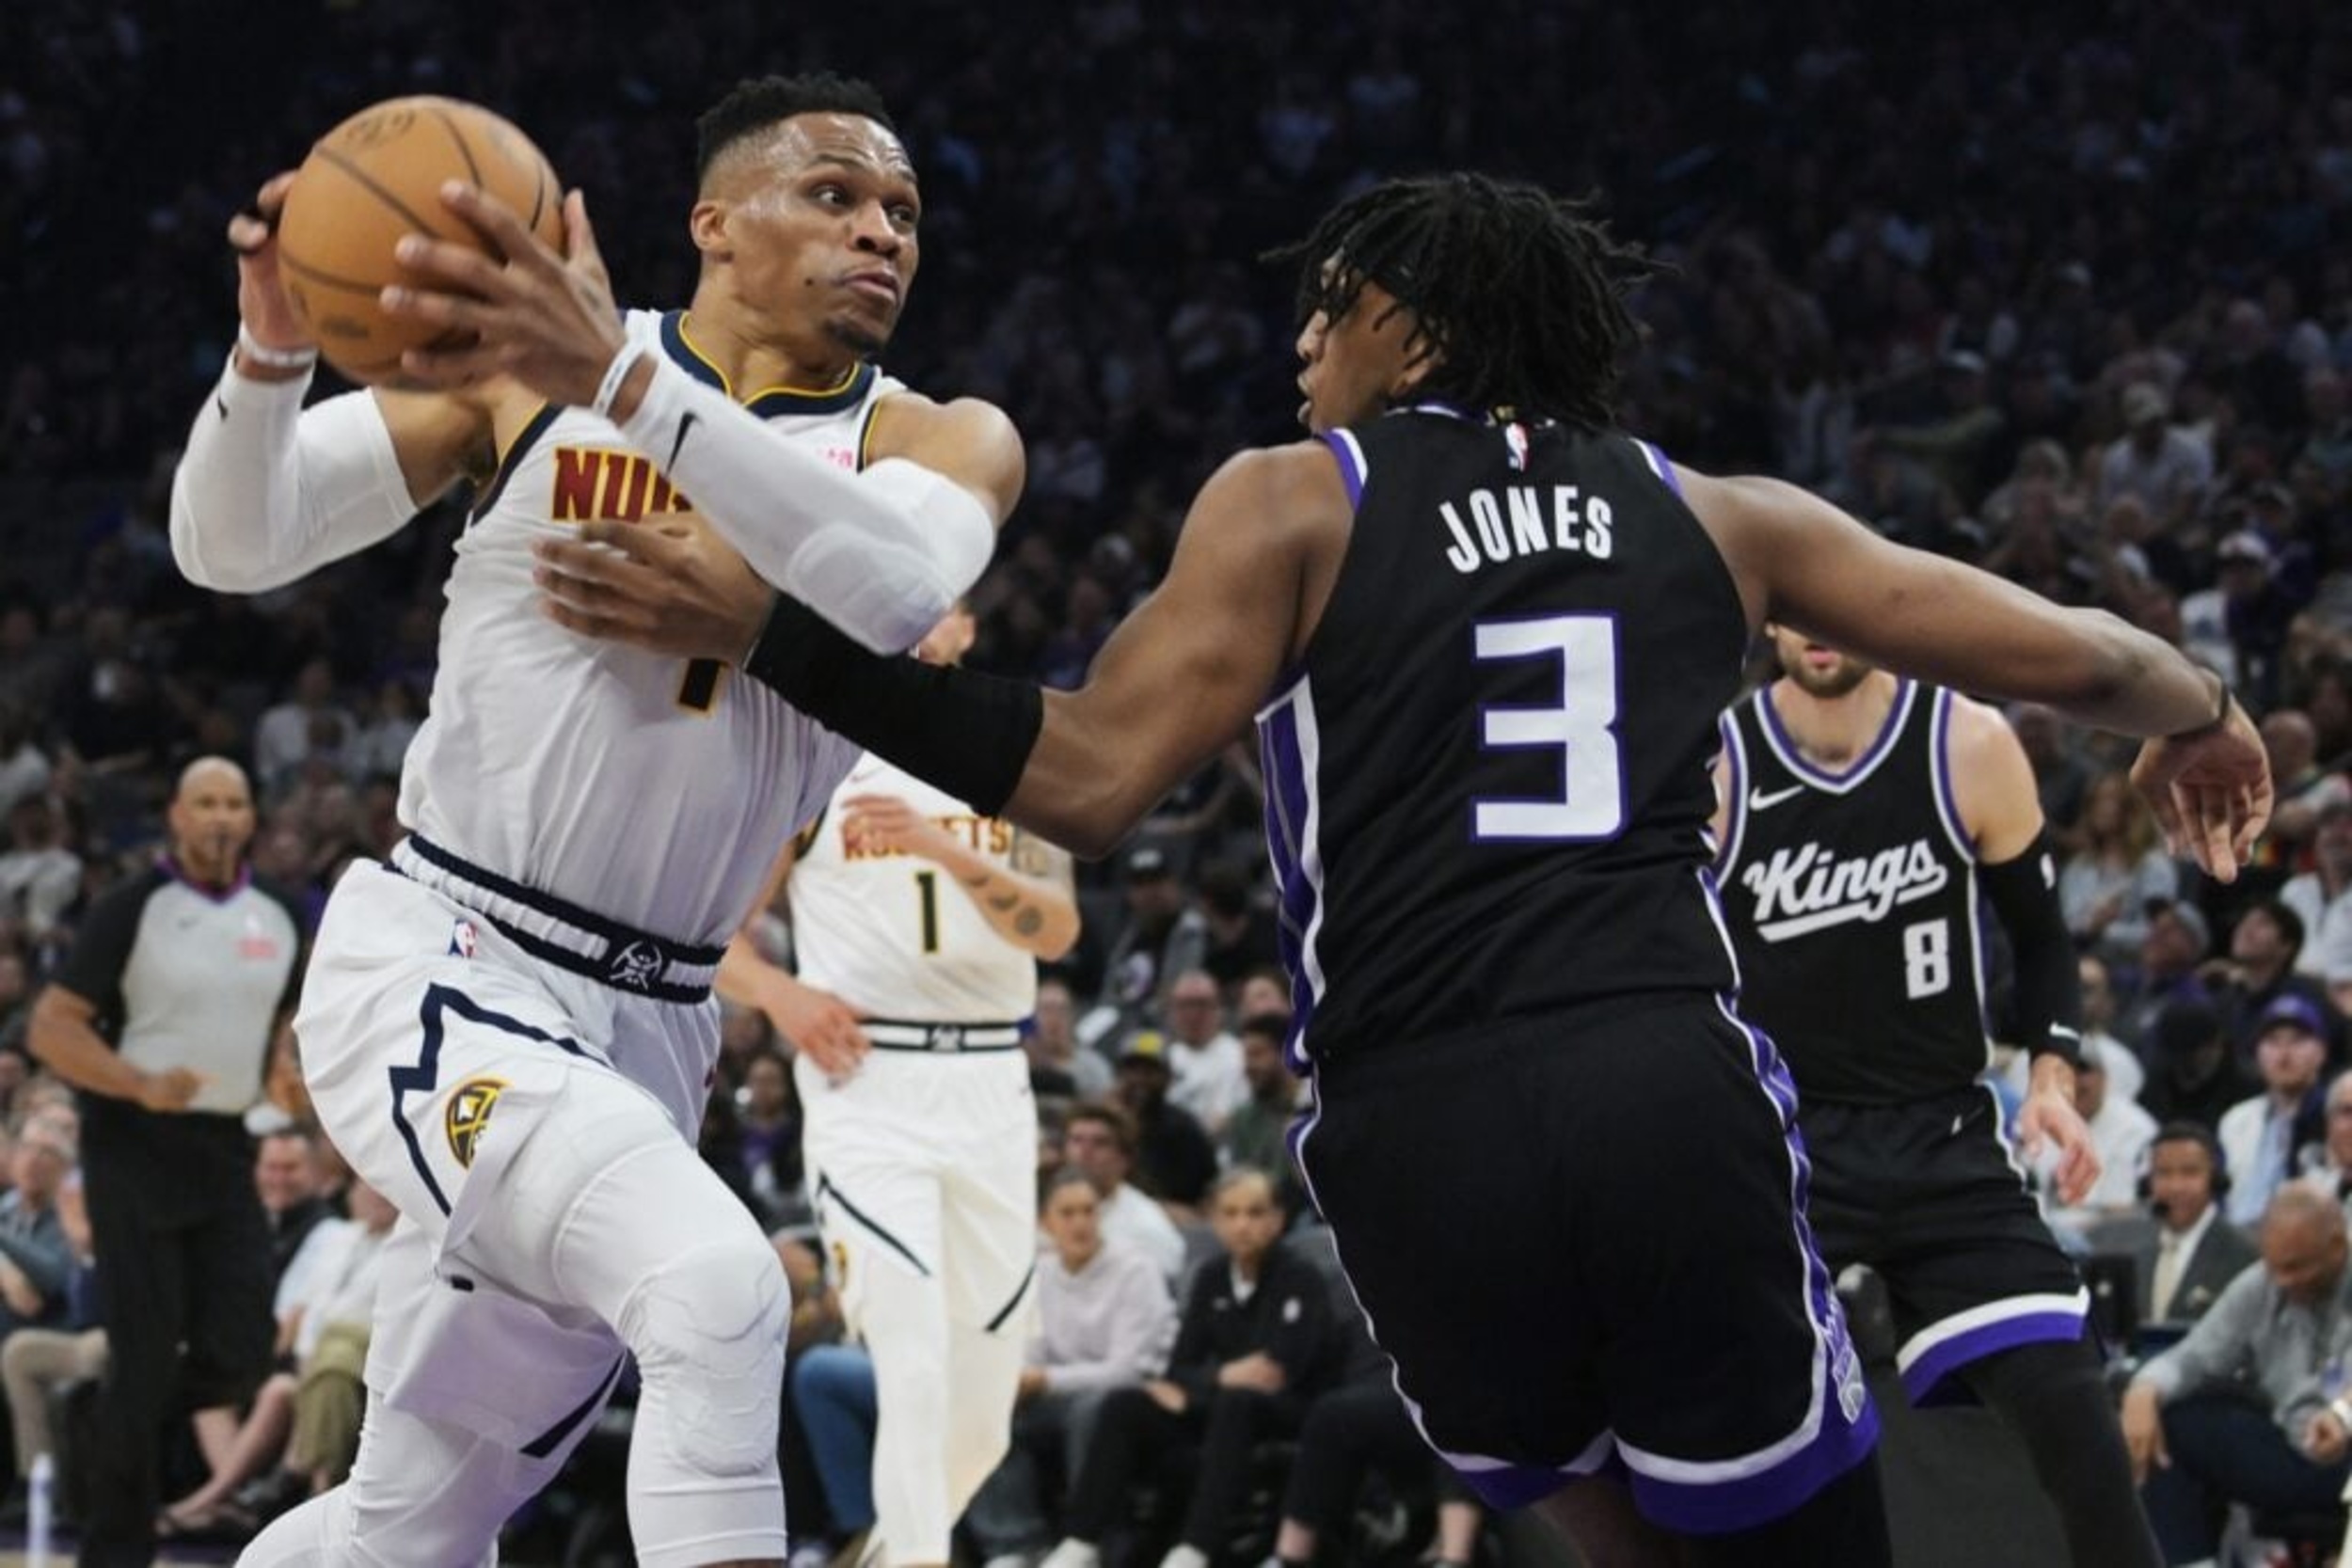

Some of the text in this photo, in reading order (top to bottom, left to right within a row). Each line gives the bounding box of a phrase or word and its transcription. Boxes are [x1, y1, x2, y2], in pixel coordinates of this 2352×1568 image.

[1439, 485, 1613, 574] JONES
[1472, 612, 1625, 840] 3
[914, 869, 938, 954] 1
[1742, 838, 1947, 942] Kings
[1903, 917, 1949, 999] 8
